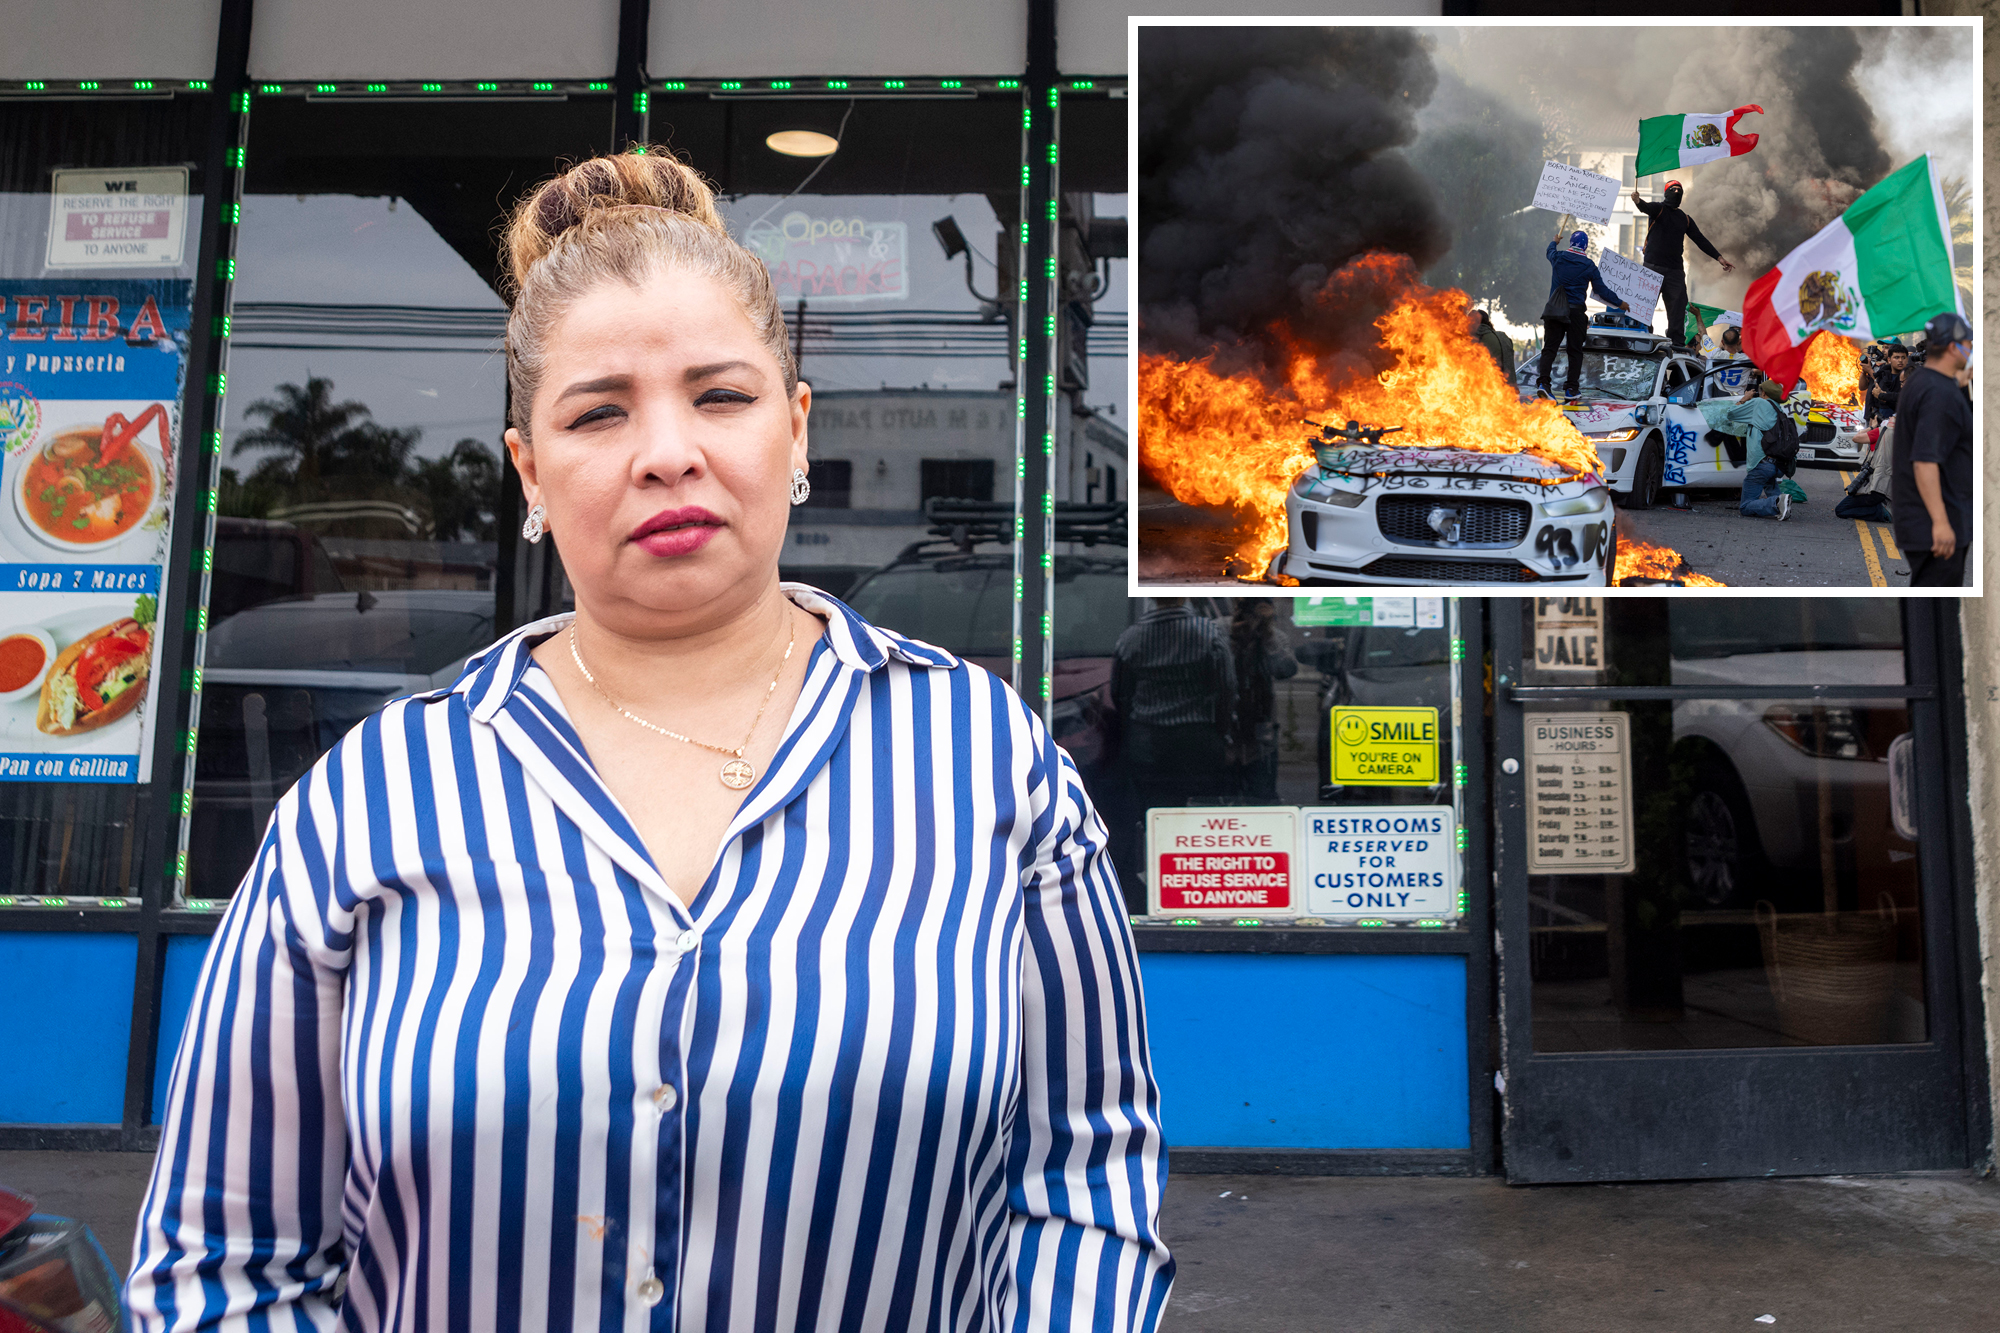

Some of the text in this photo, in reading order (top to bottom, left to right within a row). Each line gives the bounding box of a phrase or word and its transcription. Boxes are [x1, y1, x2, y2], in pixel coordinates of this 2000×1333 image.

[105, 181, 137, 192] WE
[1542, 174, 1607, 197] LOS ANGELES
[63, 195, 176, 209] RESERVE THE RIGHT
[81, 212, 156, 225] TO REFUSE
[92, 226, 142, 239] SERVICE
[783, 213, 865, 245] Open
[84, 243, 148, 255] TO ANYONE
[1612, 254, 1638, 271] STAND
[766, 259, 902, 295] ARAOKE
[1599, 261, 1632, 286] RACISM
[1607, 279, 1633, 297] STAND
[0, 295, 169, 341] EIBA
[1632, 303, 1652, 321] ICE
[6, 355, 16, 374] y
[1603, 355, 1644, 372] FK
[17, 570, 147, 590] Sopa 7 Mares
[1538, 597, 1597, 616] PULL
[1537, 636, 1598, 666] JALE
[1370, 722, 1433, 740] SMILE
[1537, 726, 1614, 739] BUSINESS
[1350, 752, 1421, 763] YOU'RE ON
[0, 757, 129, 777] Pan con Gallina
[1358, 764, 1414, 774] CAMERA
[1313, 818, 1442, 834] RESTROOMS
[1175, 835, 1272, 847] RESERVE
[1327, 840, 1428, 853] RESERVED
[1173, 856, 1276, 871] THE RIGHT TO
[1359, 856, 1396, 868] FOR
[1162, 873, 1287, 887] REFUSE SERVICE
[1314, 872, 1443, 888] CUSTOMERS
[1181, 890, 1268, 904] TO ANYONE
[1347, 892, 1410, 908] ONLY
